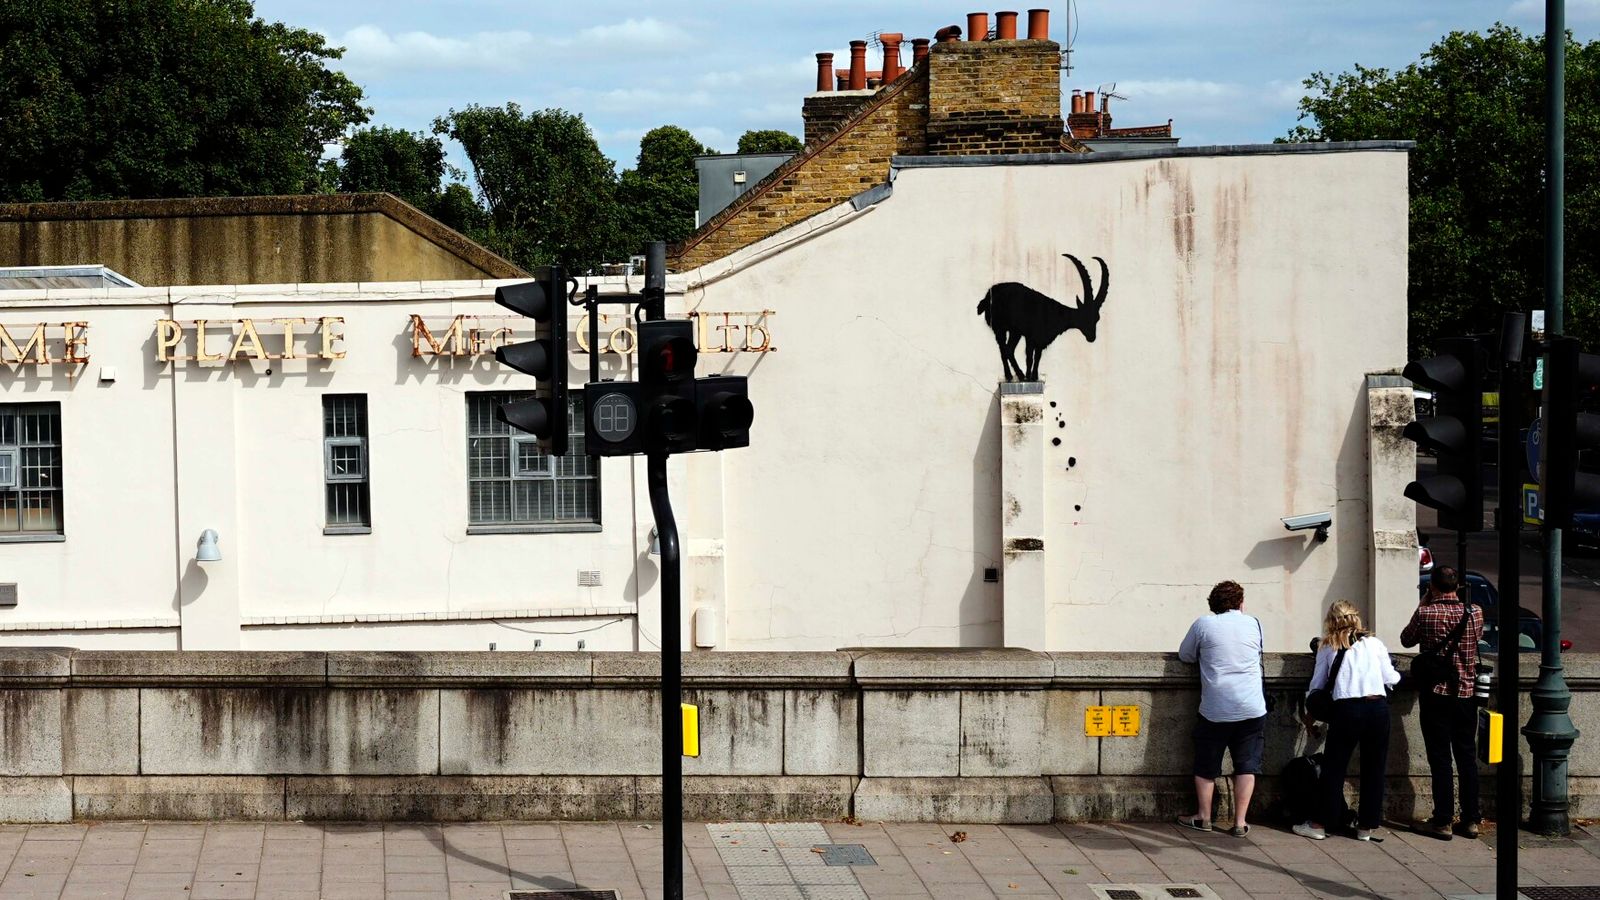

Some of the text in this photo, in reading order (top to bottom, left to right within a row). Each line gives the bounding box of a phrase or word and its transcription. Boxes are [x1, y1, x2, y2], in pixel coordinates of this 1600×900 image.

[155, 317, 346, 362] PLATE
[688, 311, 771, 353] LTD
[1528, 492, 1538, 516] P
